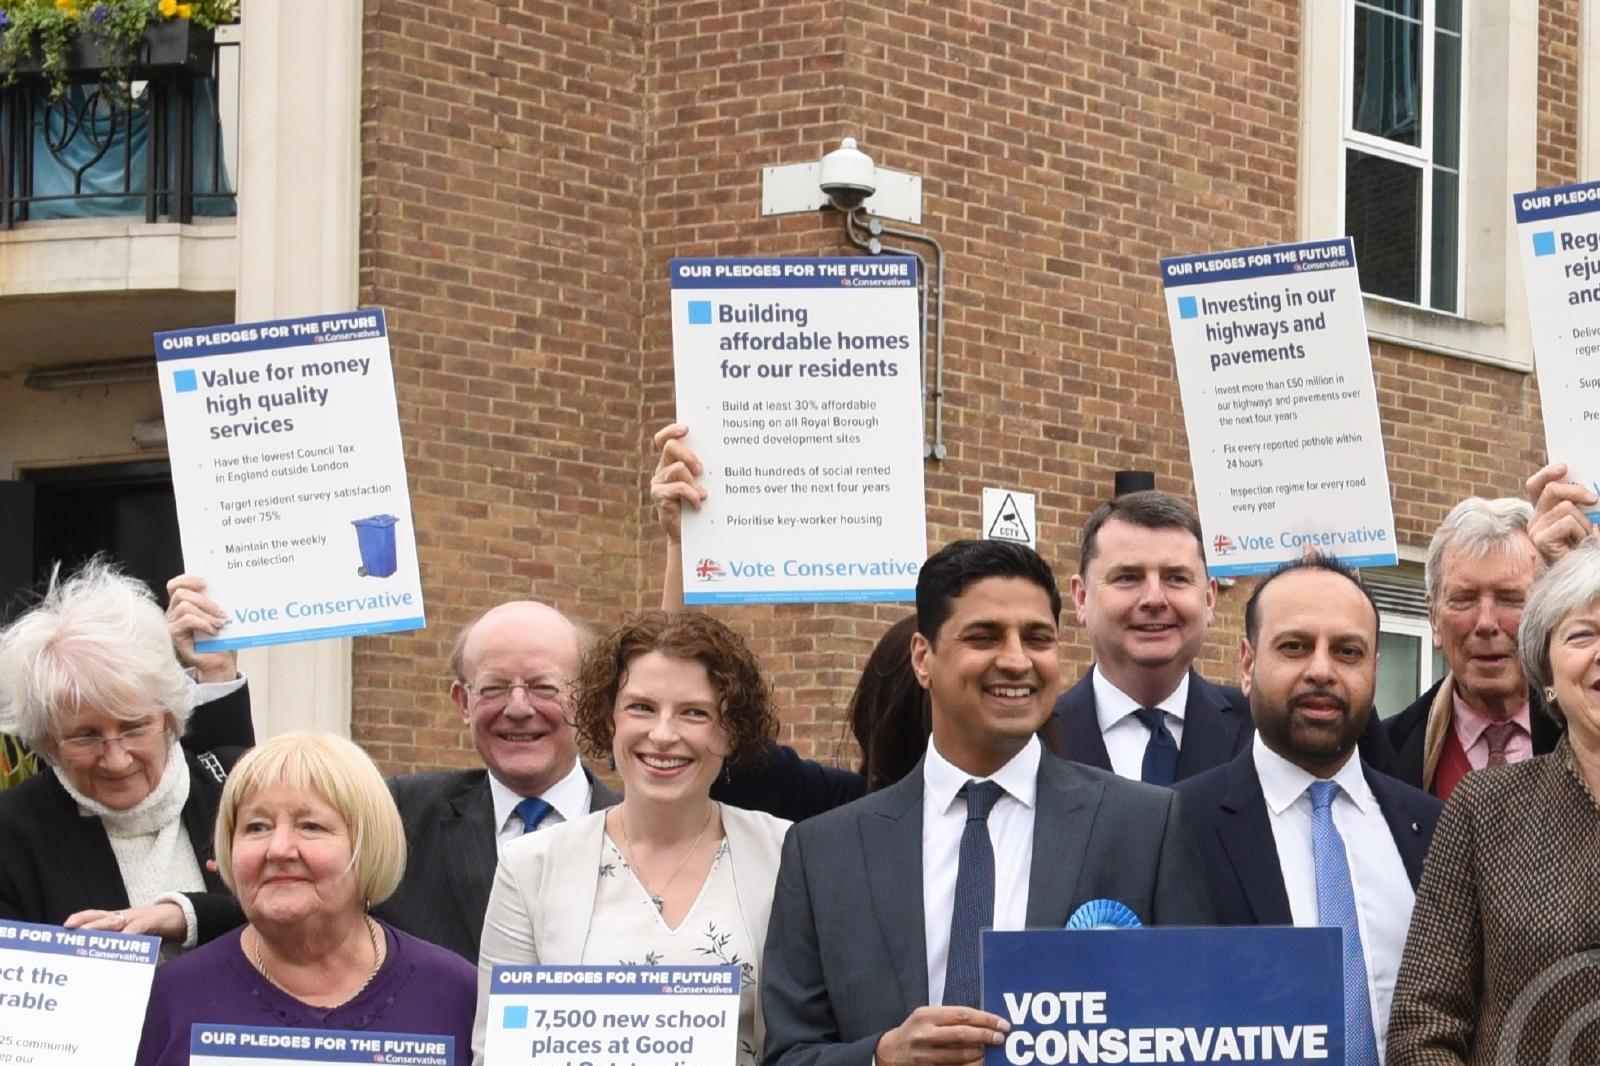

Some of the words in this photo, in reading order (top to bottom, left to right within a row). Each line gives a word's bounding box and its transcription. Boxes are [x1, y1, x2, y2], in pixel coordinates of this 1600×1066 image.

[679, 265, 712, 278] OUR
[715, 264, 782, 277] PLEDGES
[784, 264, 815, 277] FOR
[817, 264, 847, 276] THE
[850, 263, 908, 276] FUTURE
[852, 277, 911, 287] Conservatives
[1201, 291, 1282, 316] Investing
[1284, 287, 1303, 307] in
[1306, 288, 1337, 305] our
[718, 302, 808, 328] Building
[162, 336, 194, 350] OUR
[196, 328, 258, 346] PLEDGES
[260, 325, 289, 339] FOR
[291, 322, 320, 336] THE
[321, 316, 377, 333] FUTURE
[1205, 320, 1290, 345] highways
[1293, 311, 1326, 333] and
[719, 331, 833, 351] affordable
[837, 331, 910, 350] homes
[719, 359, 752, 379] for
[757, 363, 794, 379] our
[799, 357, 898, 378] residents
[1210, 342, 1306, 372] pavements
[201, 367, 260, 388] Value
[265, 363, 295, 382] for
[301, 357, 370, 377] money
[205, 392, 252, 417] high
[257, 384, 329, 412] quality
[209, 416, 294, 440] services
[1223, 443, 1237, 454] Fix
[1237, 443, 1261, 454] every
[1262, 437, 1300, 452] reported
[1301, 435, 1334, 450] pothole
[1335, 432, 1363, 445] within
[213, 458, 240, 468] Have
[241, 454, 259, 465] the
[261, 449, 295, 463] lowest
[296, 444, 335, 459] Council
[336, 444, 355, 454] Tax
[726, 514, 775, 526] Prioritise
[777, 514, 837, 528] key-worker
[840, 514, 883, 527] housing
[1000, 527, 1019, 537] CCTV
[1237, 535, 1275, 551] Vote
[1279, 526, 1386, 550] Conservative
[729, 561, 775, 578] Vote
[783, 558, 918, 577] Conservative
[234, 607, 278, 624] Vote
[285, 591, 413, 619] Conservative
[19, 928, 53, 943] FOR
[55, 932, 86, 947] THE
[88, 936, 151, 954] FUTURE
[31, 966, 68, 987] the
[534, 1009, 597, 1030] 7,500
[602, 1014, 650, 1028] new
[654, 1009, 727, 1029] school
[1003, 991, 1107, 1025] VOTE
[531, 1035, 602, 1059] places
[607, 1036, 630, 1054] at
[635, 1035, 694, 1054] Good
[1005, 1025, 1328, 1066] CONSERVATIVE
